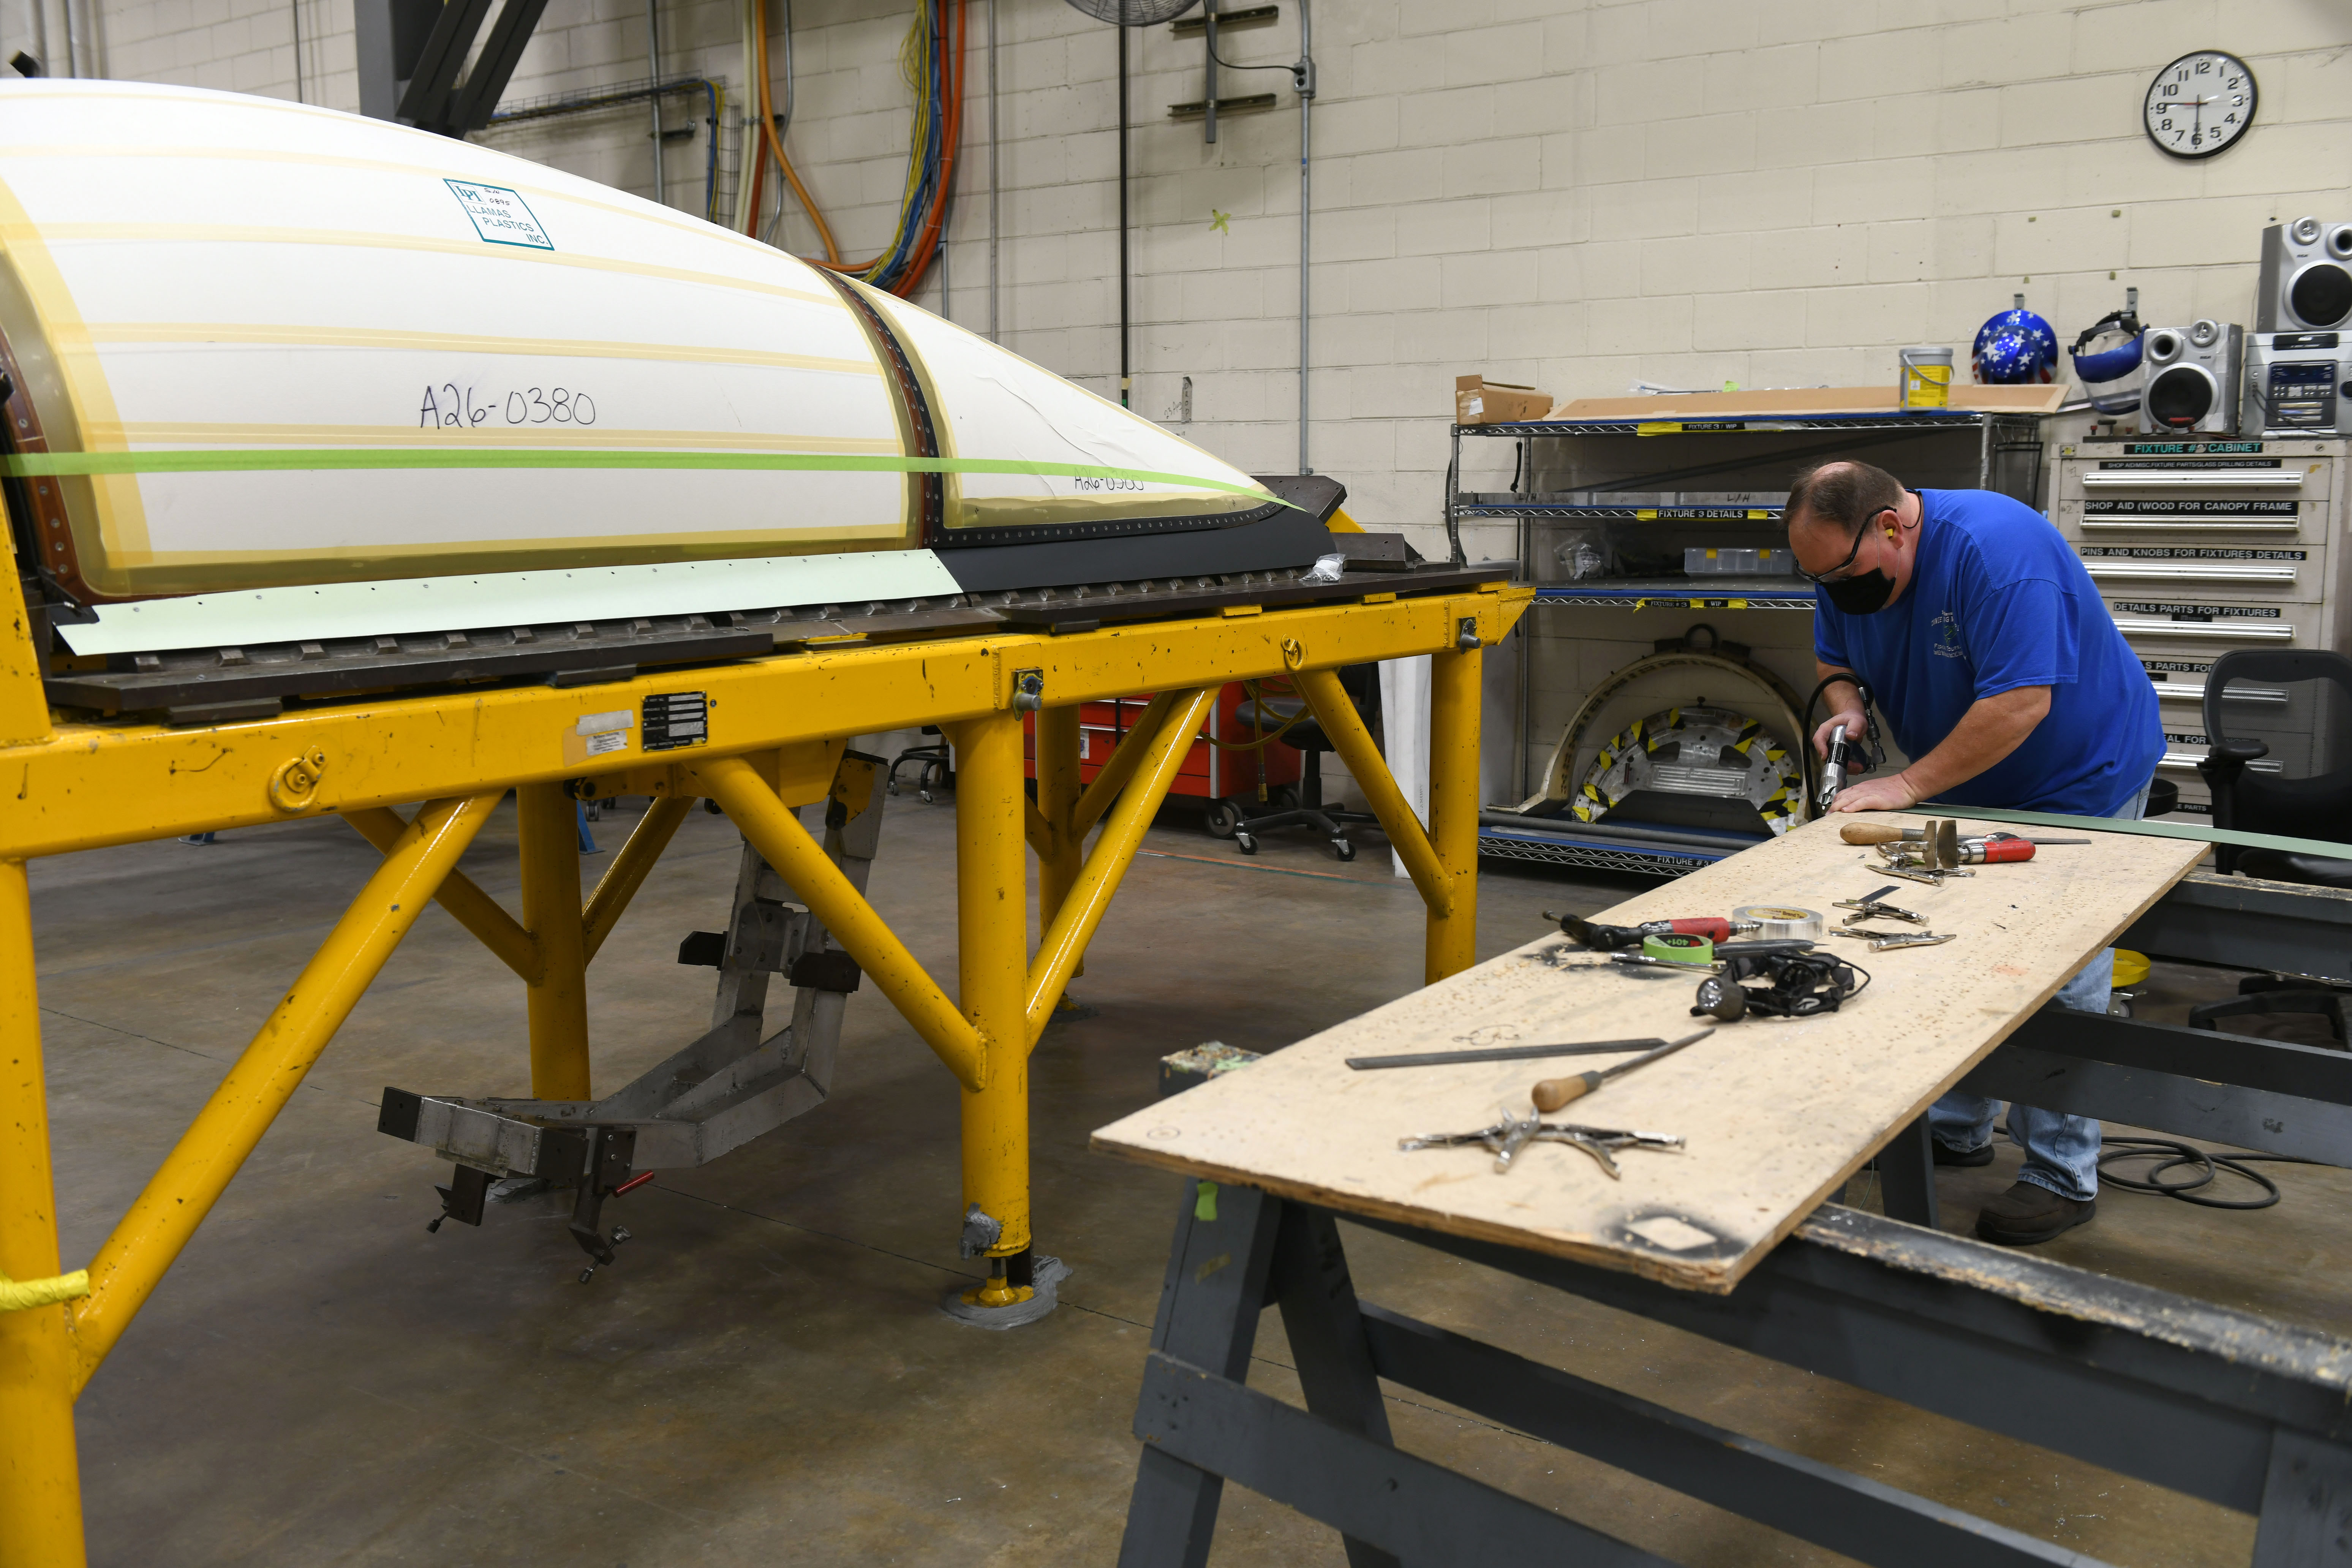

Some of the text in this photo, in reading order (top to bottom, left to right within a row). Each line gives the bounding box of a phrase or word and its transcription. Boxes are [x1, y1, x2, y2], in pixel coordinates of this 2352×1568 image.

[2195, 62, 2211, 74] 12
[2219, 66, 2224, 77] 1
[2178, 70, 2189, 82] 11
[2227, 77, 2238, 90] 2
[2162, 84, 2179, 96] 10
[2232, 95, 2243, 107] 3
[2156, 103, 2167, 114] 9
[2224, 112, 2235, 124] 4
[2161, 119, 2172, 131] 8
[2175, 130, 2185, 142] 7
[2210, 126, 2221, 138] 5
[2191, 133, 2202, 145] 6
[466, 205, 511, 218] LLAMAS
[482, 217, 534, 232] PLASTICS
[526, 233, 548, 245] INC.
[420, 384, 595, 429] A26-0380
[2134, 444, 2183, 454] FIXTURE
[2208, 443, 2261, 453] CABINET
[1727, 493, 1751, 503] L/H
[2085, 502, 2292, 511] SHOP AID (WOOD FOR CANOPY FRAME
[2200, 550, 2253, 559] FIXTURES
[2257, 551, 2302, 560] DETAILS
[2114, 603, 2276, 618] DETAILS PARTS FOR FIXTURES
[2156, 662, 2190, 672] PARTS
[2185, 735, 2206, 744] FOR
[1657, 856, 1693, 866] FIXTURE
